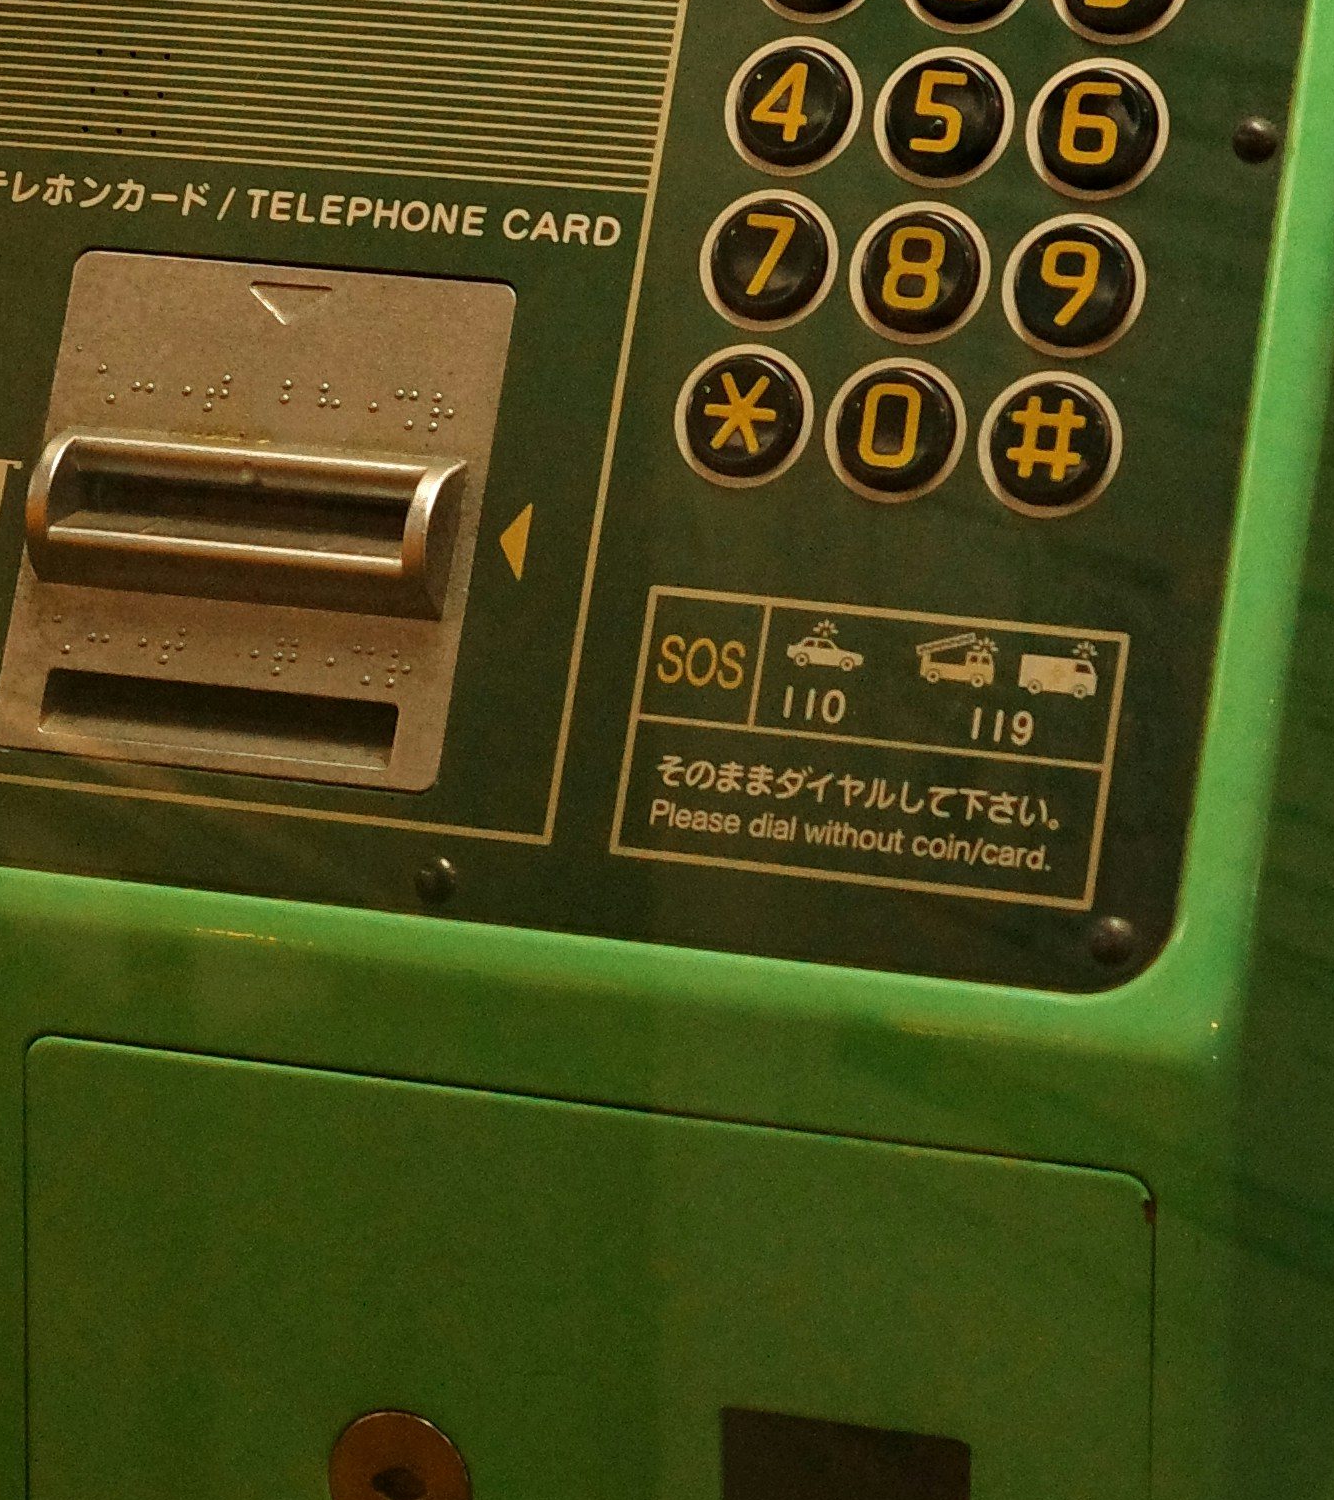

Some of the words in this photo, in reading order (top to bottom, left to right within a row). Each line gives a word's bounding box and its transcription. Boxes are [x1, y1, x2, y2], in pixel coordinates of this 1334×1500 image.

[749, 61, 809, 143] 4
[908, 69, 968, 154] 5
[1057, 81, 1123, 166] 6
[248, 189, 485, 239] TELEPHONE
[500, 207, 623, 249] CARD
[744, 213, 796, 297] 7
[881, 226, 946, 312] 8
[1039, 239, 1101, 327] 9
[858, 382, 923, 470] 0
[656, 633, 748, 692] SOS
[781, 685, 847, 725] 110
[969, 706, 1036, 748] 119
[656, 754, 1061, 833] そのままダイヤルして下さい。
[648, 799, 742, 836] Please
[748, 810, 797, 842] dial
[804, 819, 905, 856] without
[911, 832, 1053, 874] coin/card.
